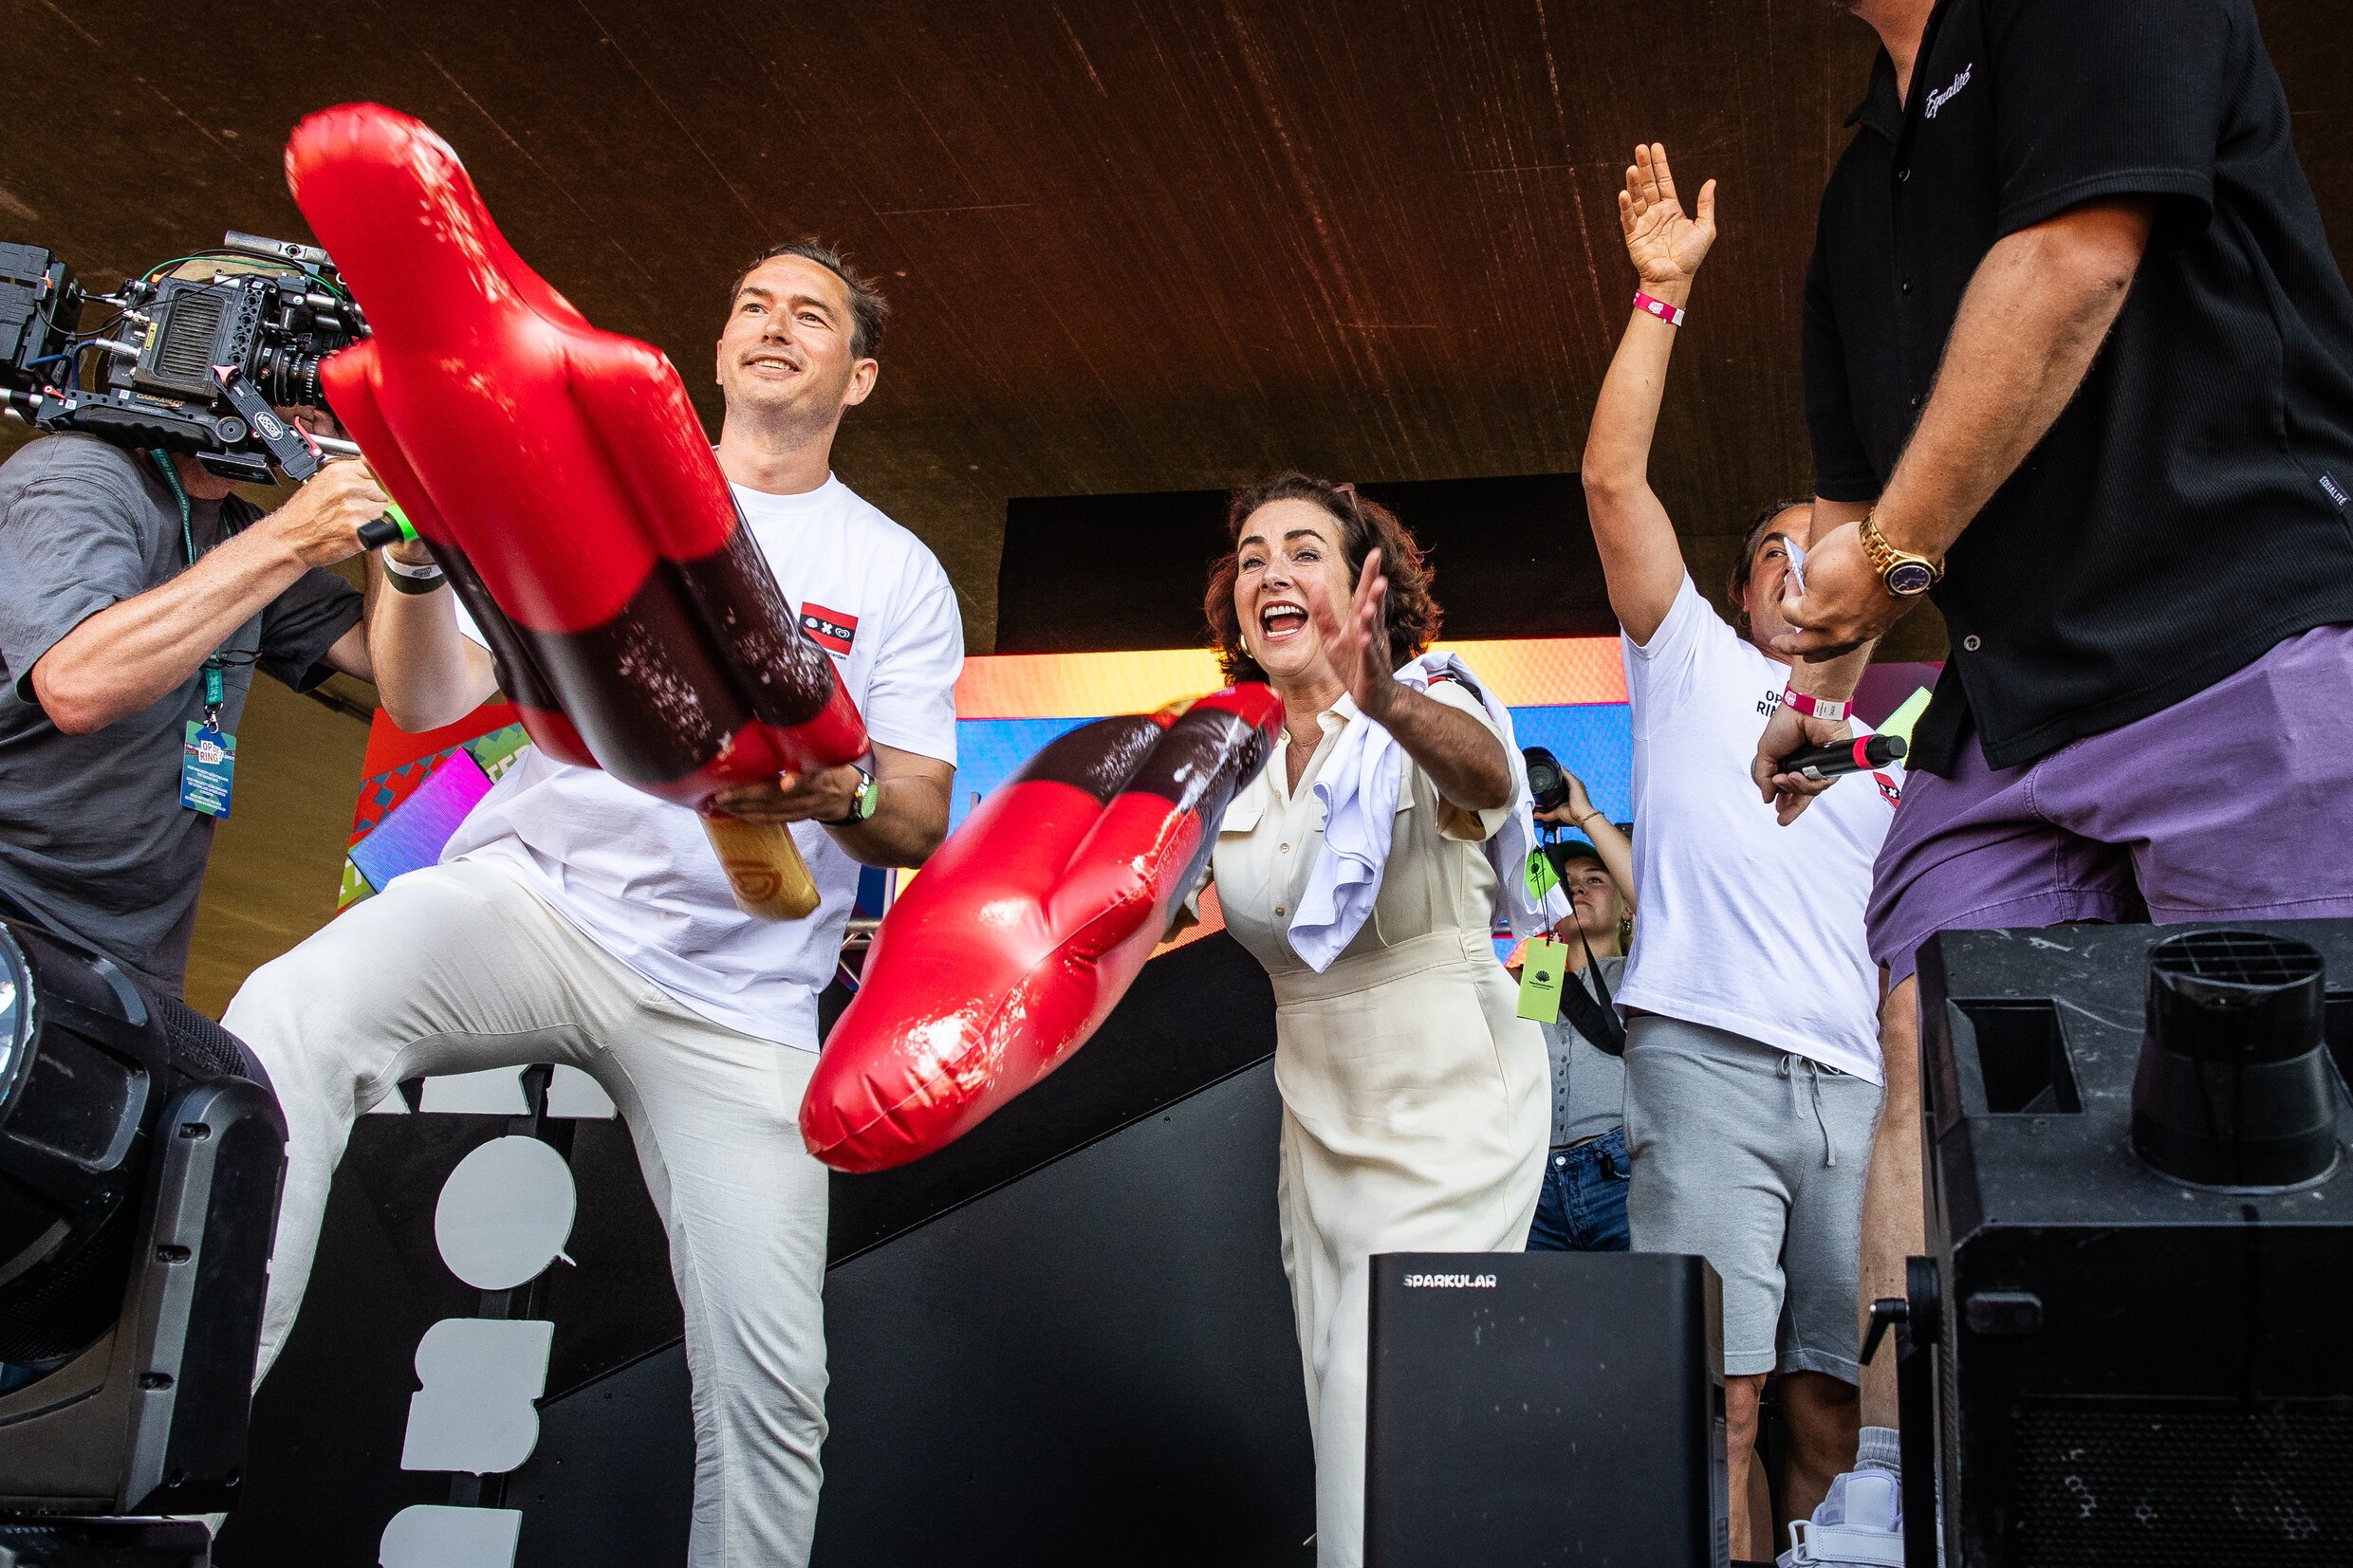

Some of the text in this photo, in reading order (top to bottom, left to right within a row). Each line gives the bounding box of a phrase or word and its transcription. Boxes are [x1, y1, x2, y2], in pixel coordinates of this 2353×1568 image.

[2319, 475, 2347, 507] EQUALITÉ
[1766, 690, 1783, 704] OP
[203, 742, 213, 751] OP
[1403, 1274, 1497, 1288] SPARKULAR
